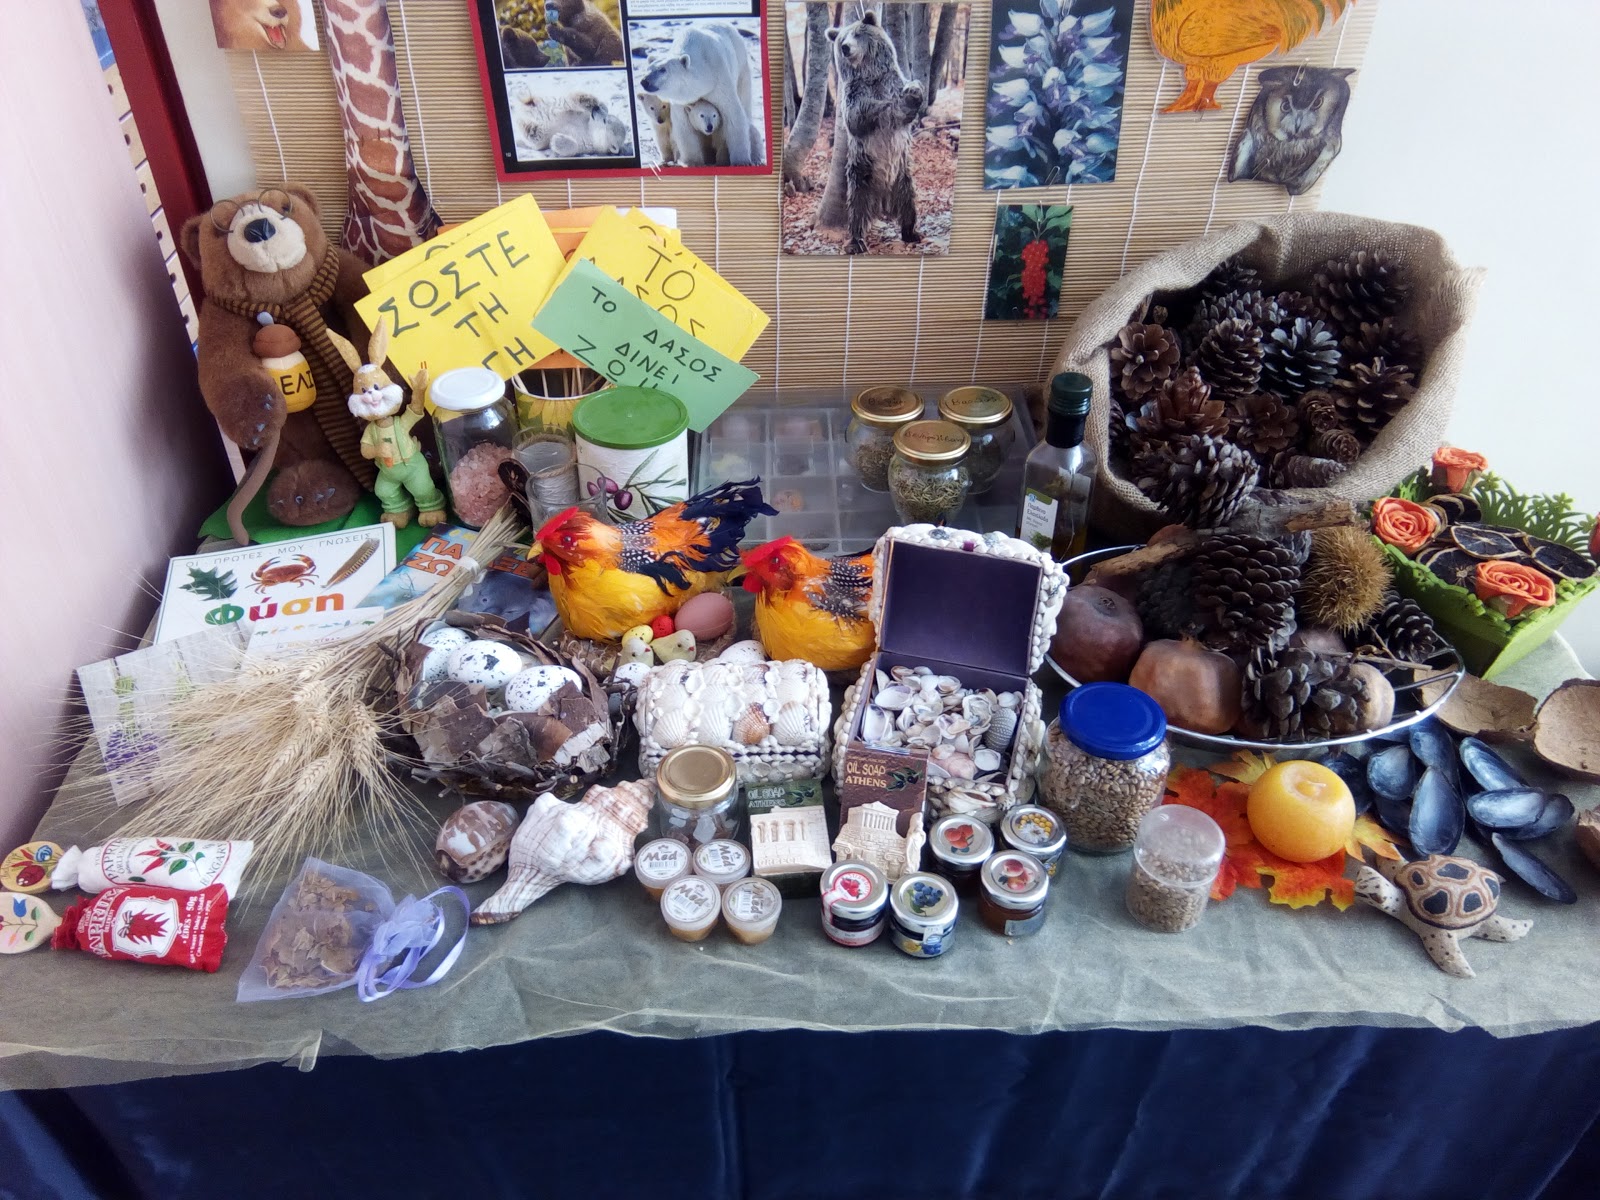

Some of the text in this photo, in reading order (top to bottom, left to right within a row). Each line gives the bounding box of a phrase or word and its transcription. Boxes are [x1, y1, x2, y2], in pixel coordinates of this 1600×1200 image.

[377, 230, 531, 338] ΣΩΣΤΕ
[648, 245, 695, 301] ΤΟ
[454, 291, 509, 338] ΤΗ
[591, 286, 723, 383] ΤΟ ΔΑΣΟΣ
[481, 336, 536, 371] ΓΗ
[615, 342, 680, 385] ΔΙΝΕΙ
[280, 370, 315, 396] ΕΛΙ
[213, 551, 263, 566] ΠΡΩΤΕΣ
[277, 544, 305, 555] ΜΟΥ
[318, 532, 373, 549] ΓΝΩΣΕΙΣ
[204, 592, 345, 626] Φύση
[845, 775, 887, 788] ATHENS
[847, 761, 886, 777] OIL SOAP
[748, 786, 786, 800] OIL SOAP
[748, 799, 786, 808] ATHENS
[104, 839, 123, 881] PAPRIK
[185, 896, 198, 912] 50g
